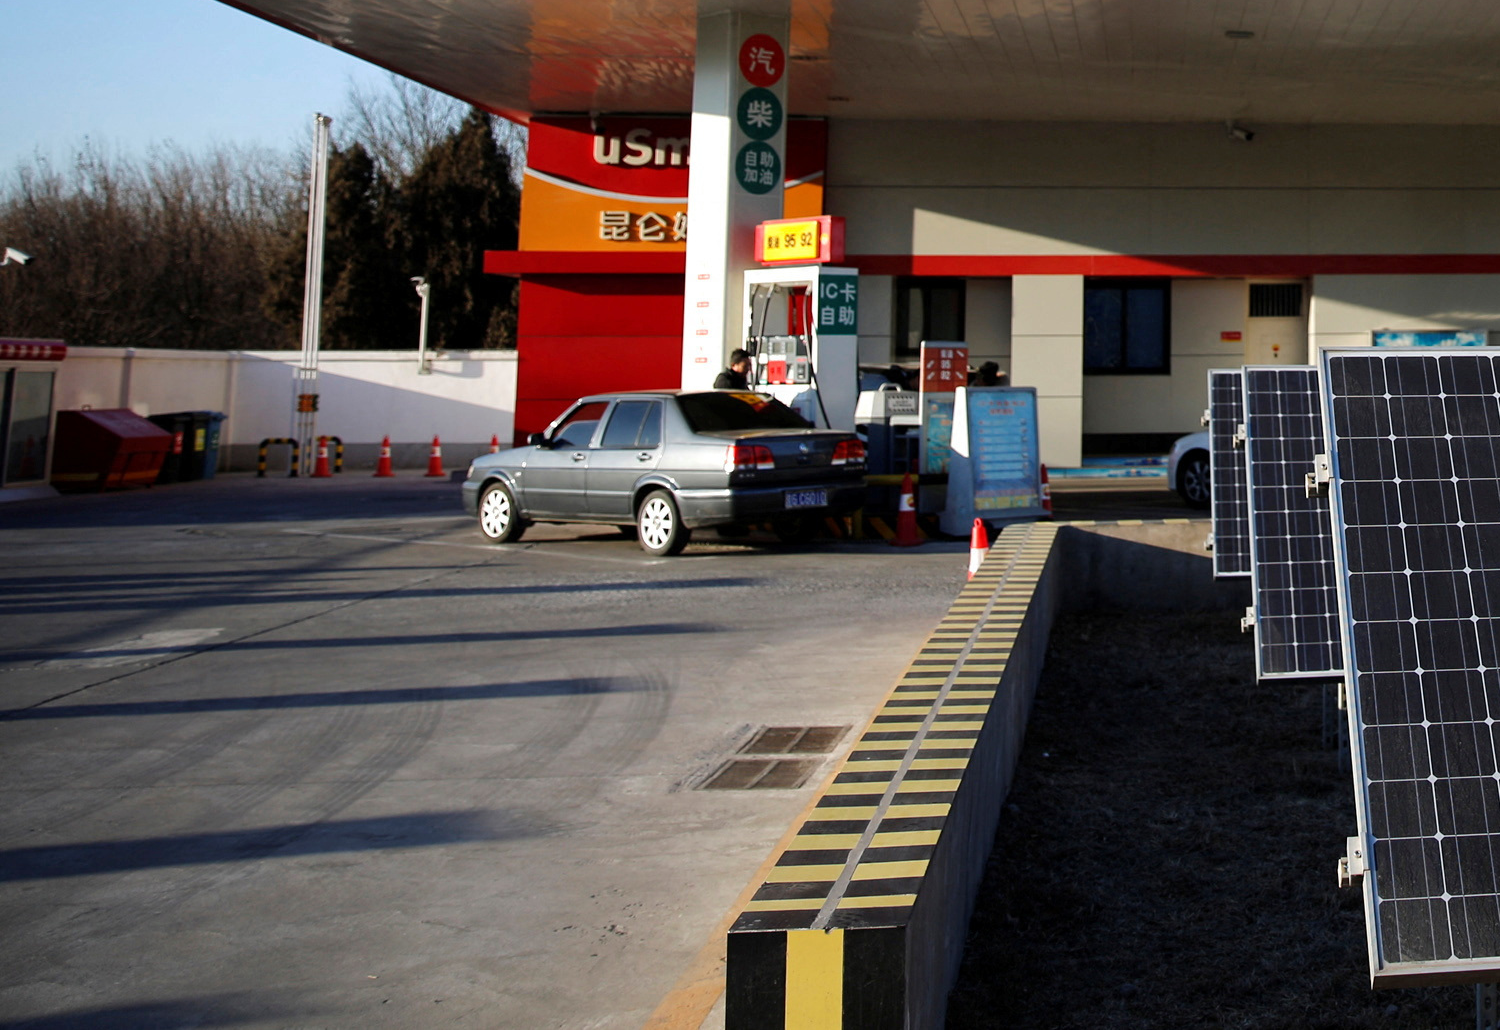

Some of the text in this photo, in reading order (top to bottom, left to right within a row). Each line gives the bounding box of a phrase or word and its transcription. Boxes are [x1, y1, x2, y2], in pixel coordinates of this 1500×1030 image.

[749, 47, 775, 75] 汽
[747, 100, 773, 128] 柴
[745, 150, 774, 168] 自助
[744, 167, 773, 186] 加油
[784, 233, 796, 248] 95
[801, 232, 812, 247] 92
[820, 282, 856, 303] IC卡
[821, 306, 855, 325] 自助
